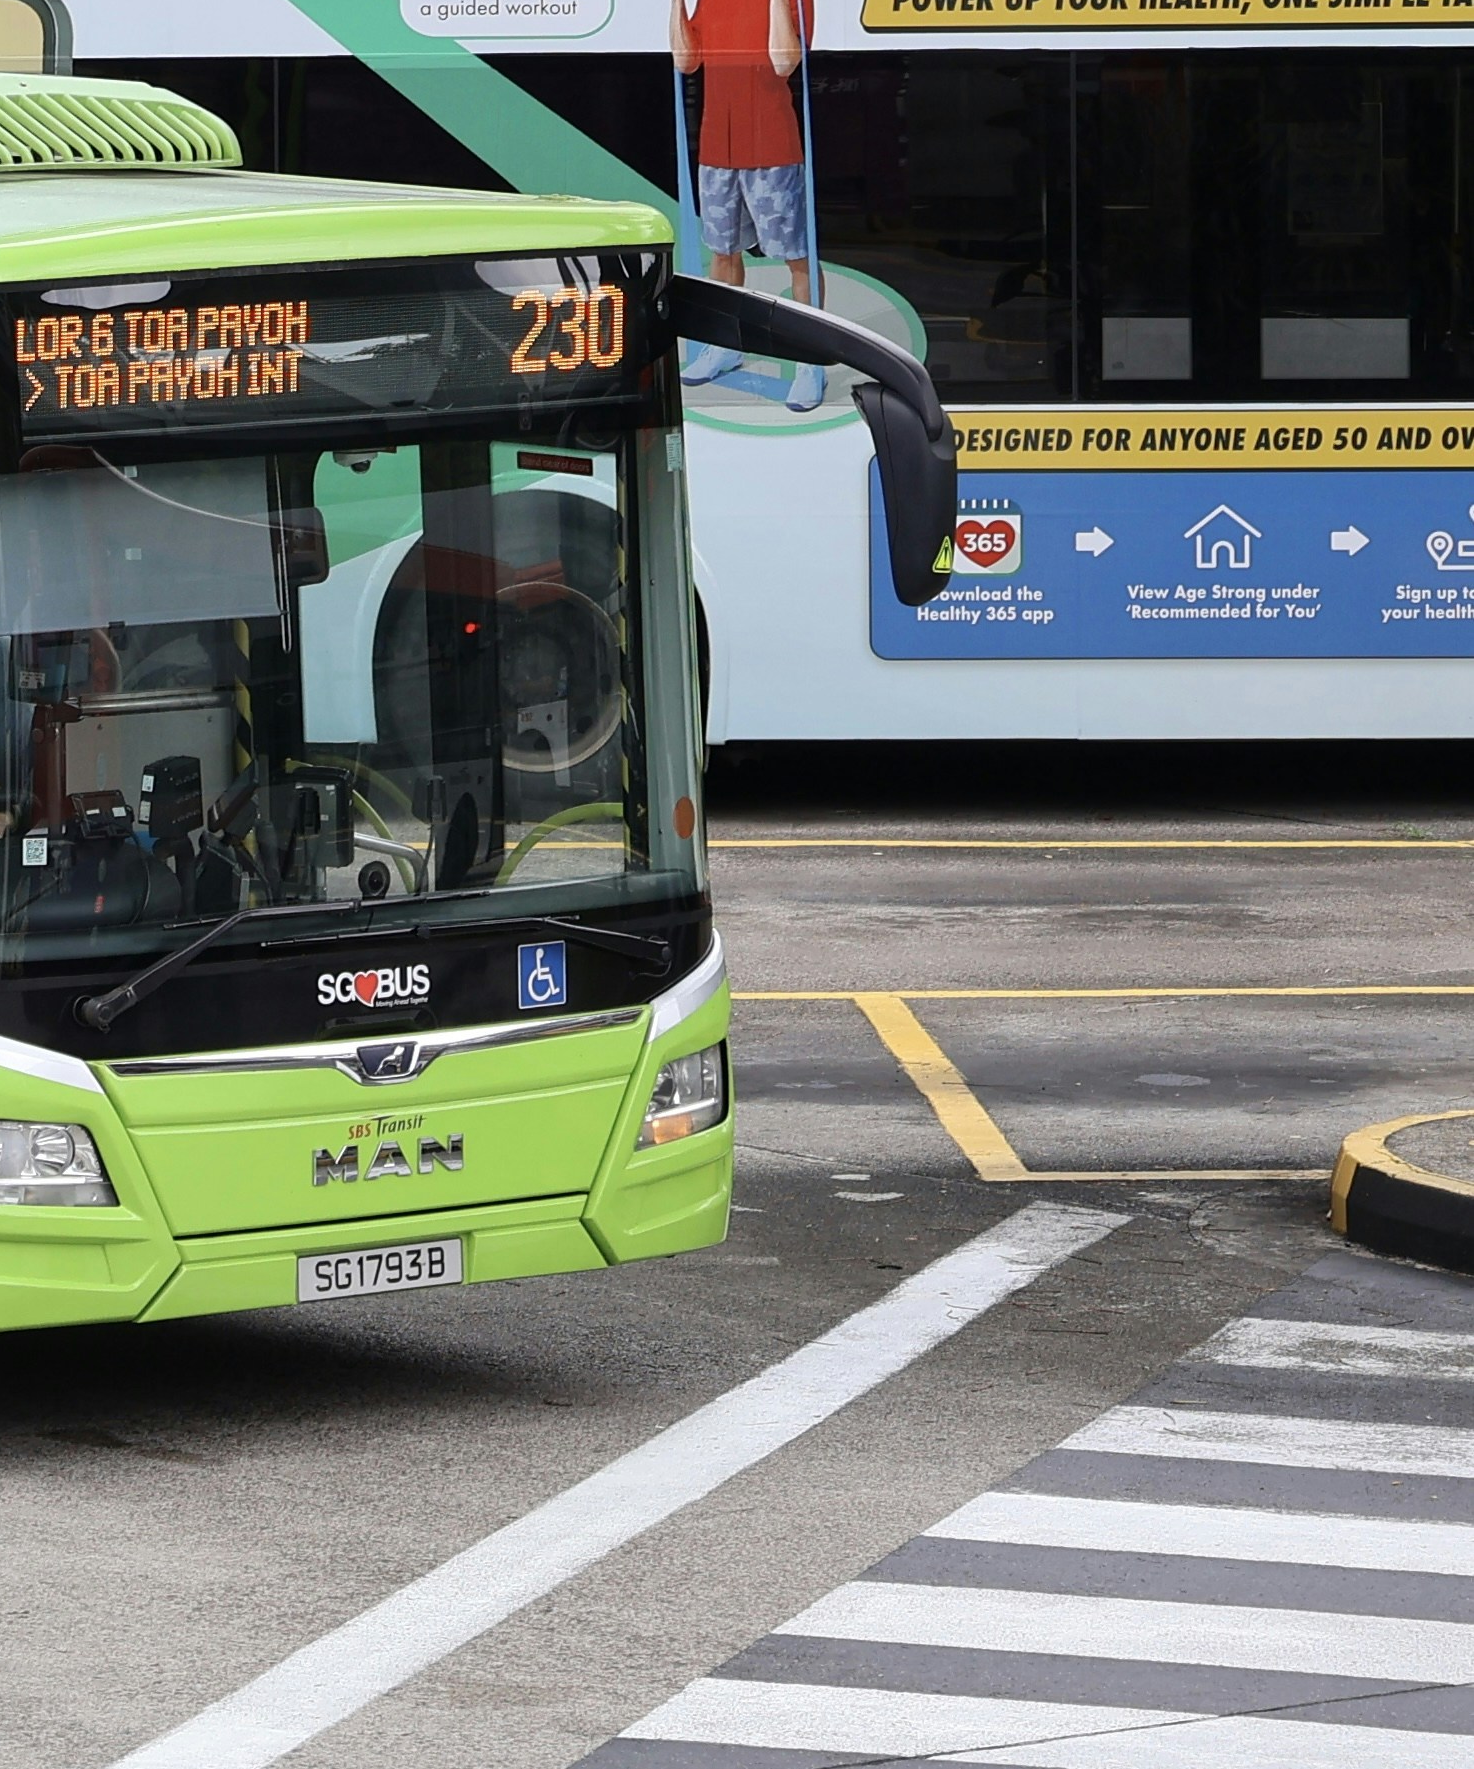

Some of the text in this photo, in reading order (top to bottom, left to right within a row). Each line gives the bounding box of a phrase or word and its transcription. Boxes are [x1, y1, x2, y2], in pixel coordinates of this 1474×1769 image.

[420, 3, 432, 16] a
[15, 300, 309, 363] LOR 6 TOA PAYOH
[510, 283, 625, 374] 230
[54, 349, 304, 410] TOA PAYOH INT
[953, 428, 1073, 452] DESIGNED
[1082, 428, 1132, 451] FOR
[1139, 427, 1248, 451] ANYONE
[1253, 427, 1324, 451] AGED
[1332, 426, 1369, 450] 50
[1376, 426, 1432, 450] AND
[963, 533, 1007, 553] 365
[932, 585, 1043, 601] ownload the
[1126, 584, 1320, 602] View Age Strong under
[1396, 584, 1432, 603] Sign
[1436, 589, 1458, 604] up
[917, 606, 1054, 624] Healthy 365 app
[1255, 603, 1281, 619] for
[1381, 608, 1421, 623] your
[348, 1114, 427, 1140] SBS Transit
[312, 1132, 464, 1187] MAN
[314, 1246, 446, 1293] SG1793B
